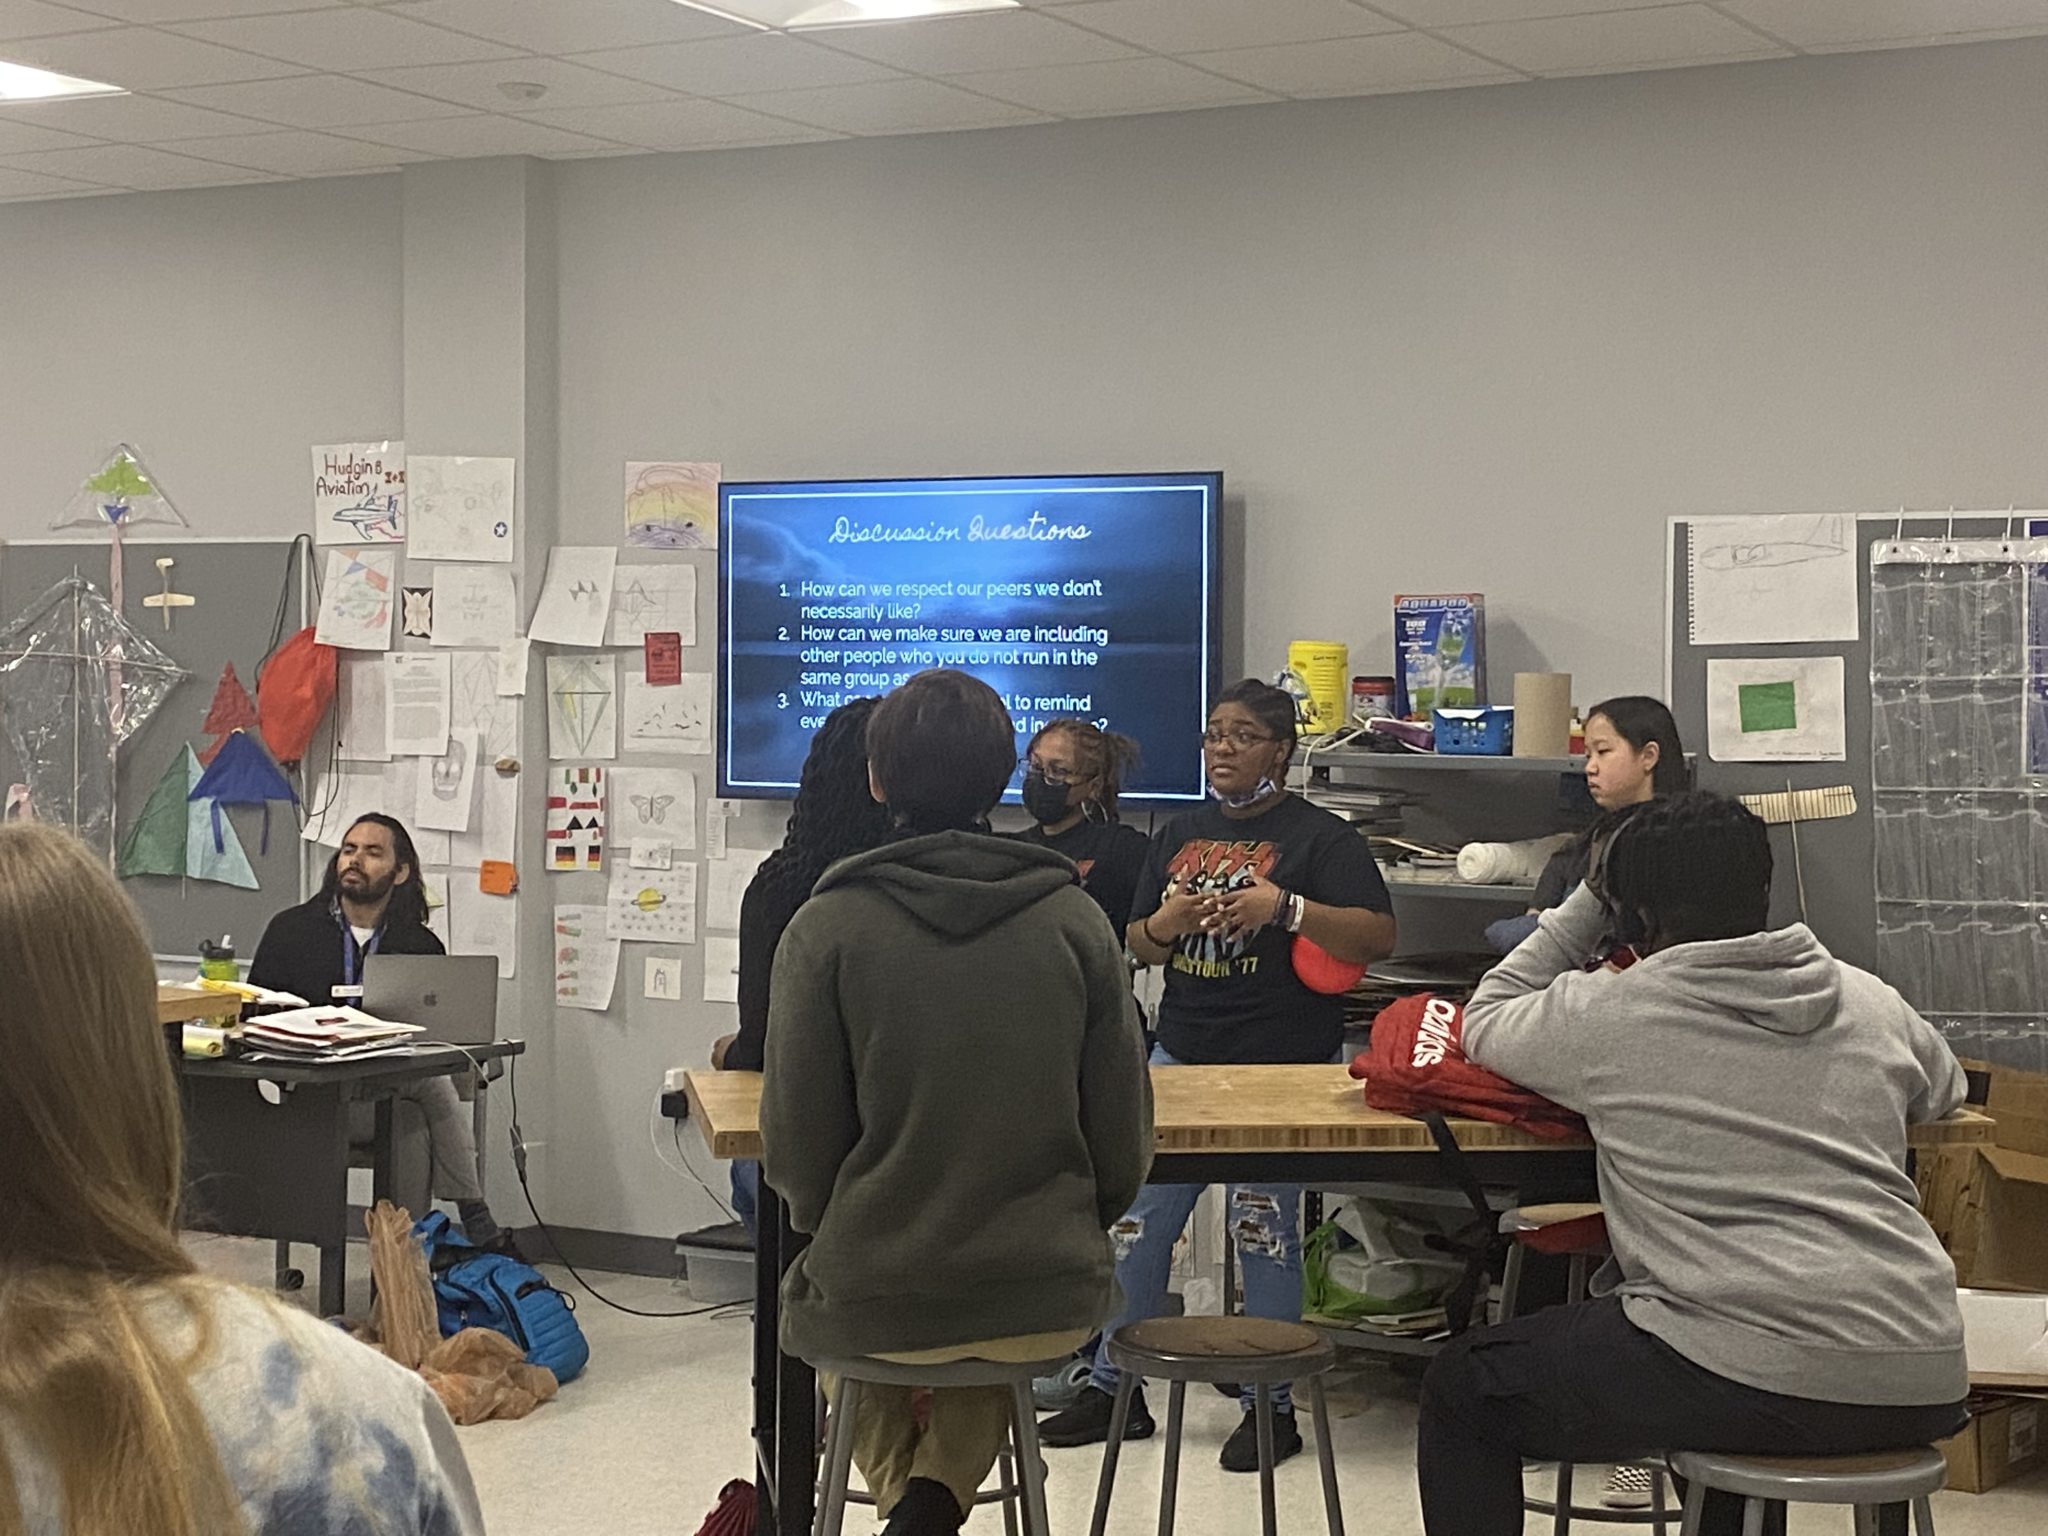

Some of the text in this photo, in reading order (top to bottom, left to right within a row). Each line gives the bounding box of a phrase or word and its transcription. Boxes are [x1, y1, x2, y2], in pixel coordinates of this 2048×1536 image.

[316, 475, 370, 497] Aviation
[828, 510, 1092, 543] Discussion Questions
[801, 581, 835, 597] How
[838, 585, 866, 597] can
[869, 584, 892, 597] we
[896, 580, 952, 599] respect
[957, 584, 982, 596] our
[986, 583, 1032, 600] peers
[1034, 583, 1060, 596] we
[1062, 579, 1103, 596] don't
[801, 603, 921, 623] necessarily like?
[1400, 598, 1468, 610] AQUAPOD
[801, 625, 835, 641] How
[838, 628, 865, 641] can
[869, 628, 892, 641] we
[895, 624, 938, 641] make
[941, 628, 974, 641] sure
[977, 628, 1002, 641] we
[1005, 628, 1031, 642] are
[1034, 625, 1108, 647] including
[800, 647, 1098, 668] other people who you do not run in the
[800, 672, 910, 689] same group as
[800, 690, 841, 708] What
[1015, 694, 1031, 710] to
[1034, 693, 1092, 711] remind
[1411, 998, 1457, 1068] adidas
